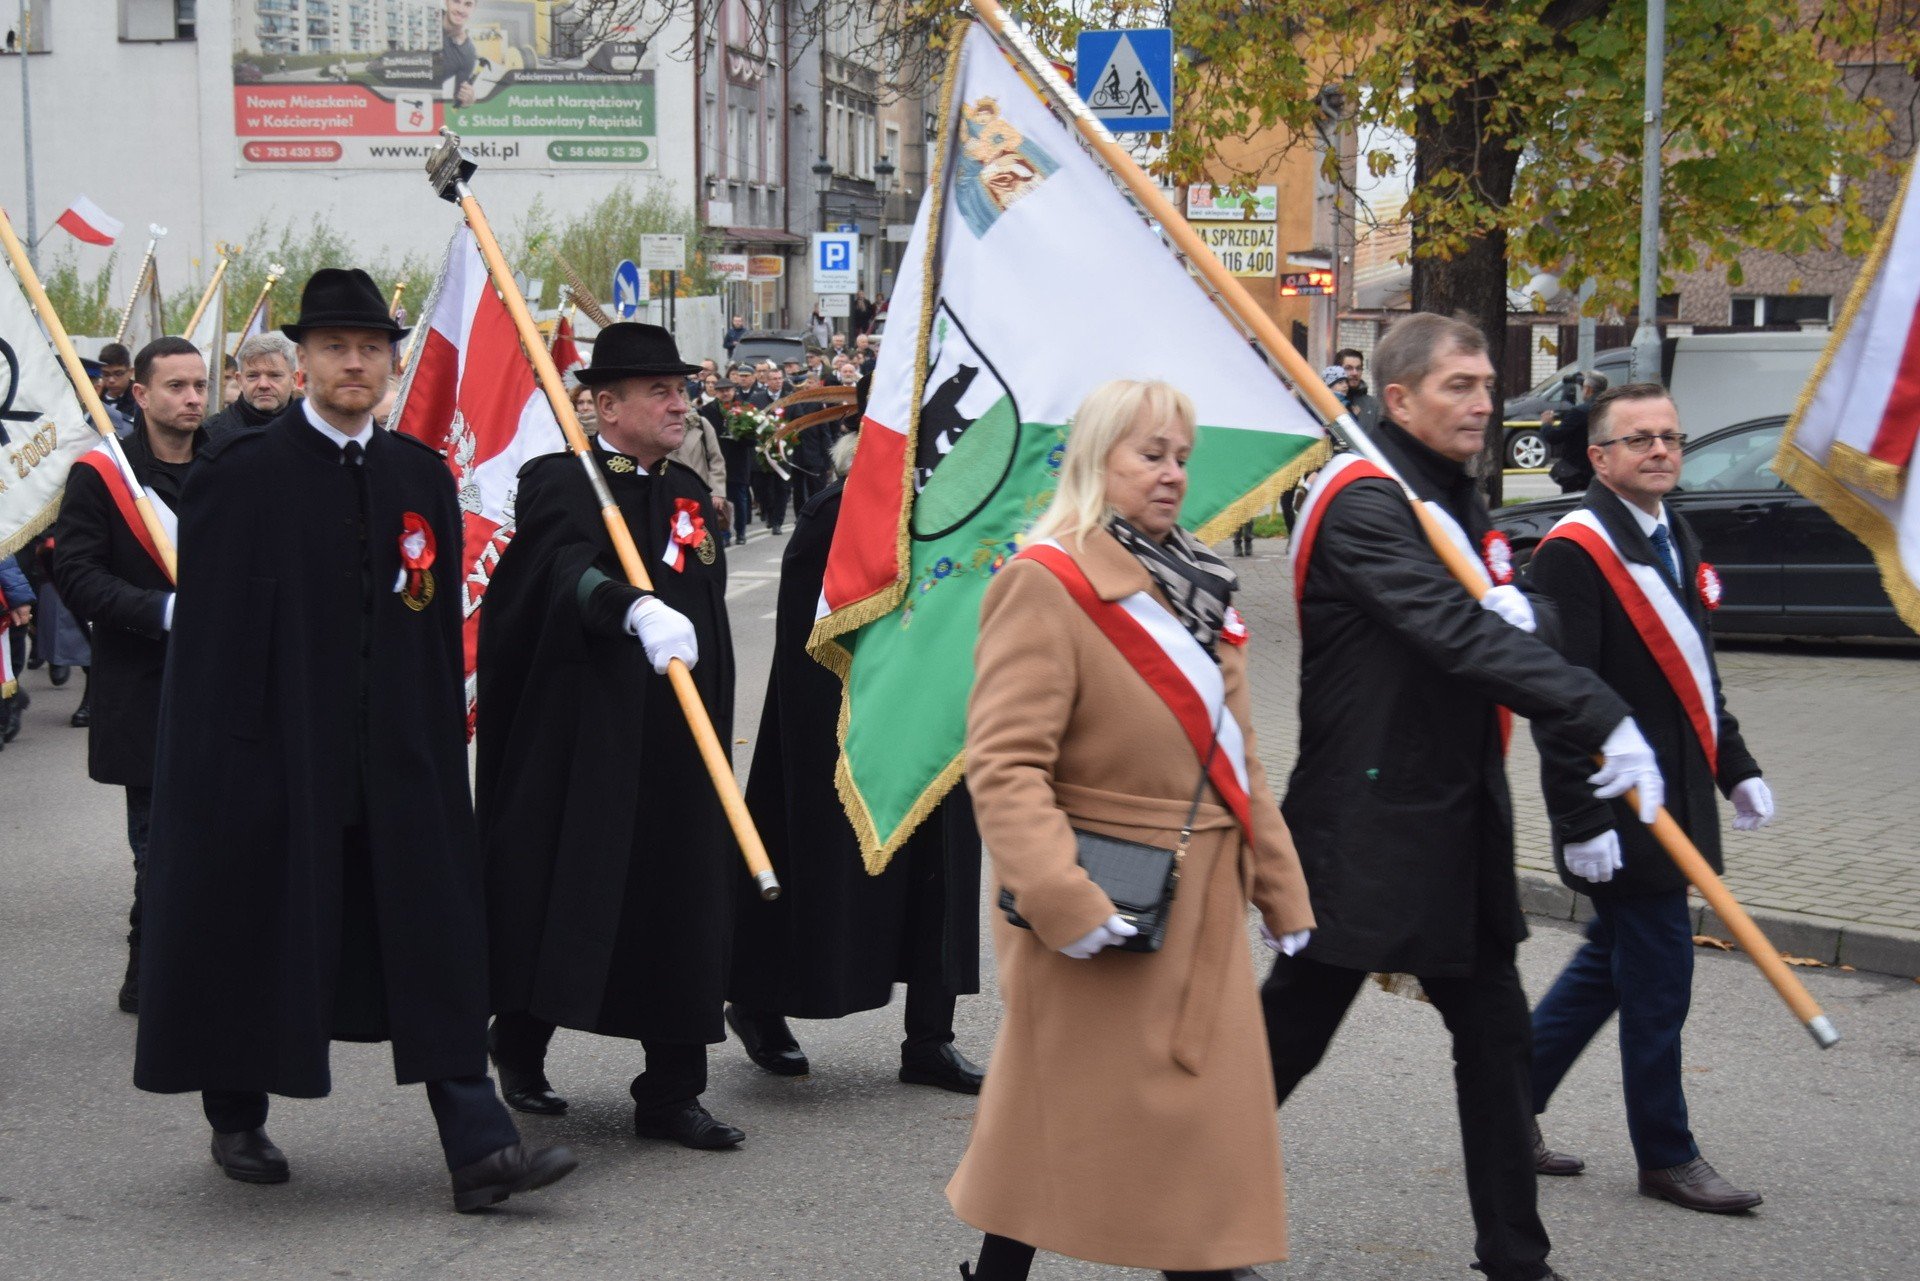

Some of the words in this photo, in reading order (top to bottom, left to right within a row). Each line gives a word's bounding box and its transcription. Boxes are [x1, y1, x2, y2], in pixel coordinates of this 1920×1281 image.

[246, 96, 286, 108] Nowe
[289, 96, 367, 108] Mieszkania
[508, 95, 555, 108] Market
[557, 95, 643, 110] Narzędziowy
[247, 117, 260, 127] w
[263, 115, 354, 130] Kościerzynie!
[457, 115, 468, 127] &
[472, 115, 508, 127] Skład
[512, 115, 585, 130] Budowlany
[588, 115, 643, 129] Repiński
[370, 142, 520, 160] www.rski.pl
[569, 147, 584, 157] 58
[1211, 226, 1274, 247] SPRZEDAŻ
[826, 243, 845, 268] P
[1222, 251, 1243, 272] 116
[1247, 251, 1274, 272] 400
[10, 421, 58, 479] 2007
